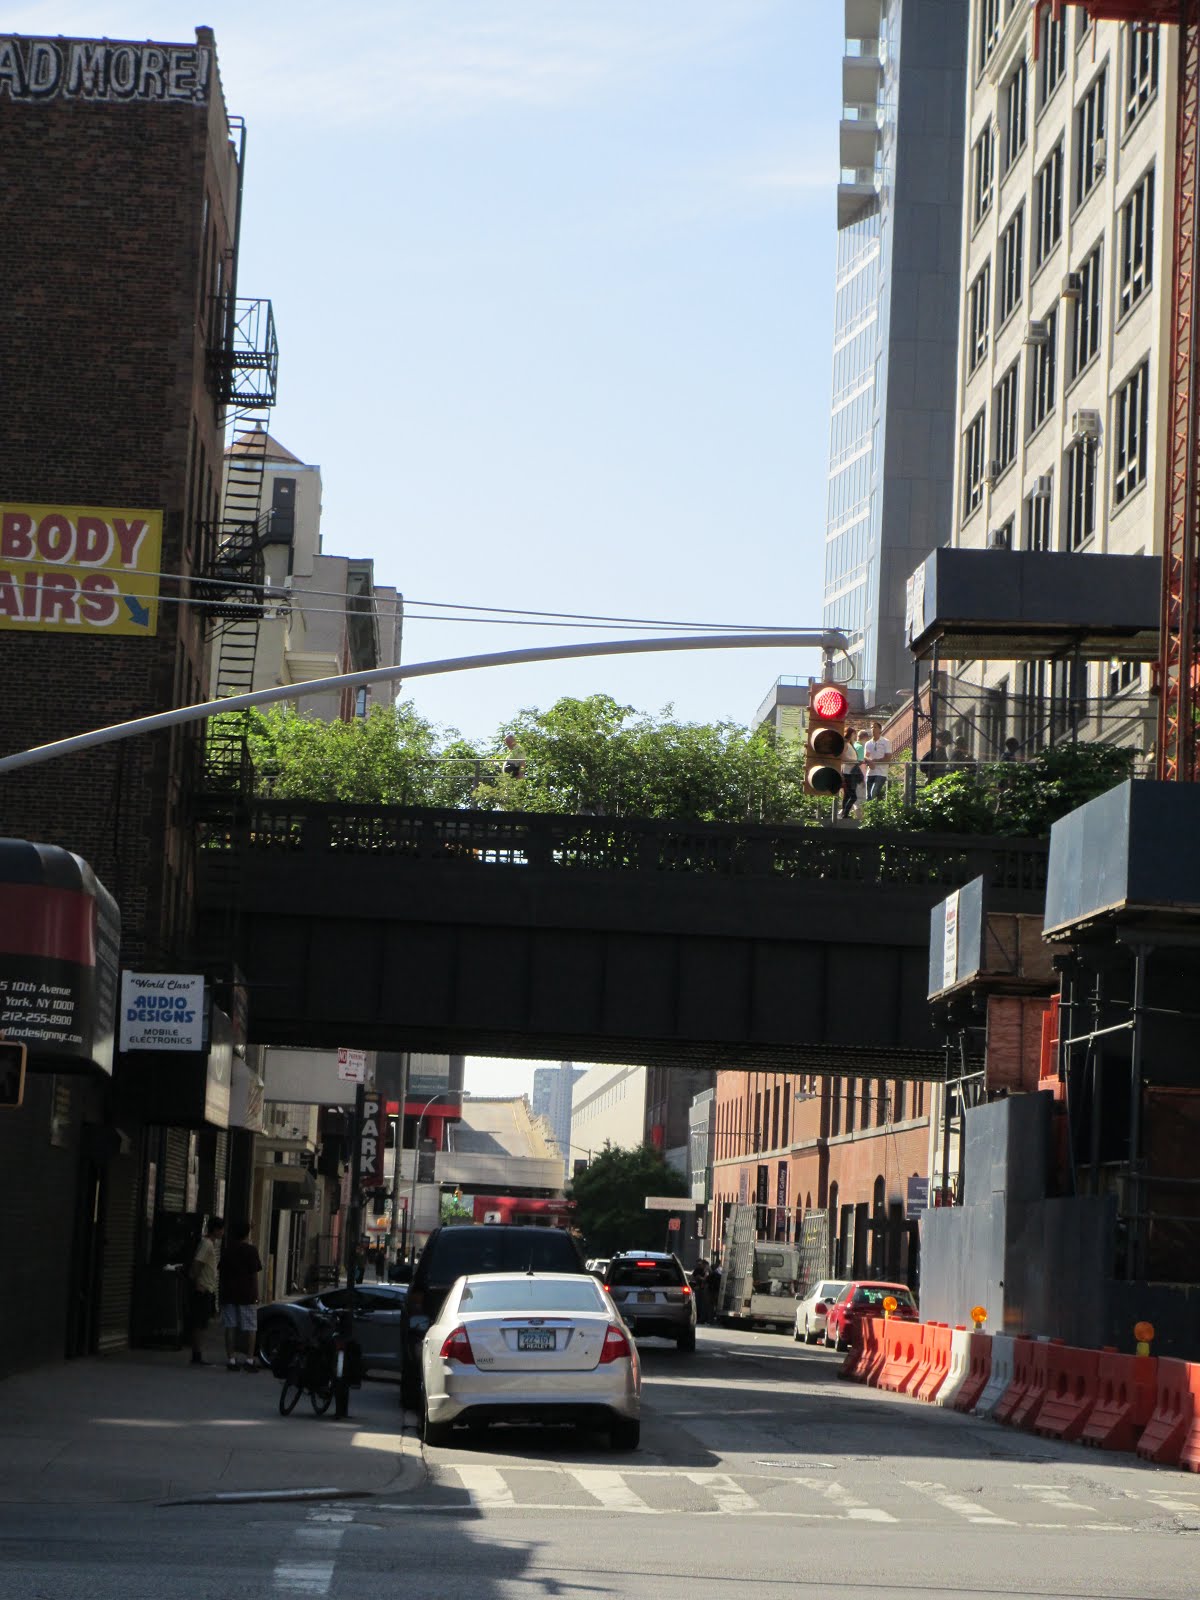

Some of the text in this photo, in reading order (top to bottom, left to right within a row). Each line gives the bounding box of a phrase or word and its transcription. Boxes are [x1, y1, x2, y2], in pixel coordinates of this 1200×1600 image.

[2, 512, 149, 569] BODY
[12, 981, 36, 992] 10th
[39, 984, 71, 996] Avenue
[6, 996, 32, 1008] York,
[37, 998, 51, 1008] NY
[134, 995, 187, 1010] AUDIO
[2, 1011, 72, 1025] 212-255-8900
[127, 1009, 196, 1023] DESIGNS
[129, 1036, 193, 1045] ELECTRONICS
[360, 1102, 379, 1173] PARK
